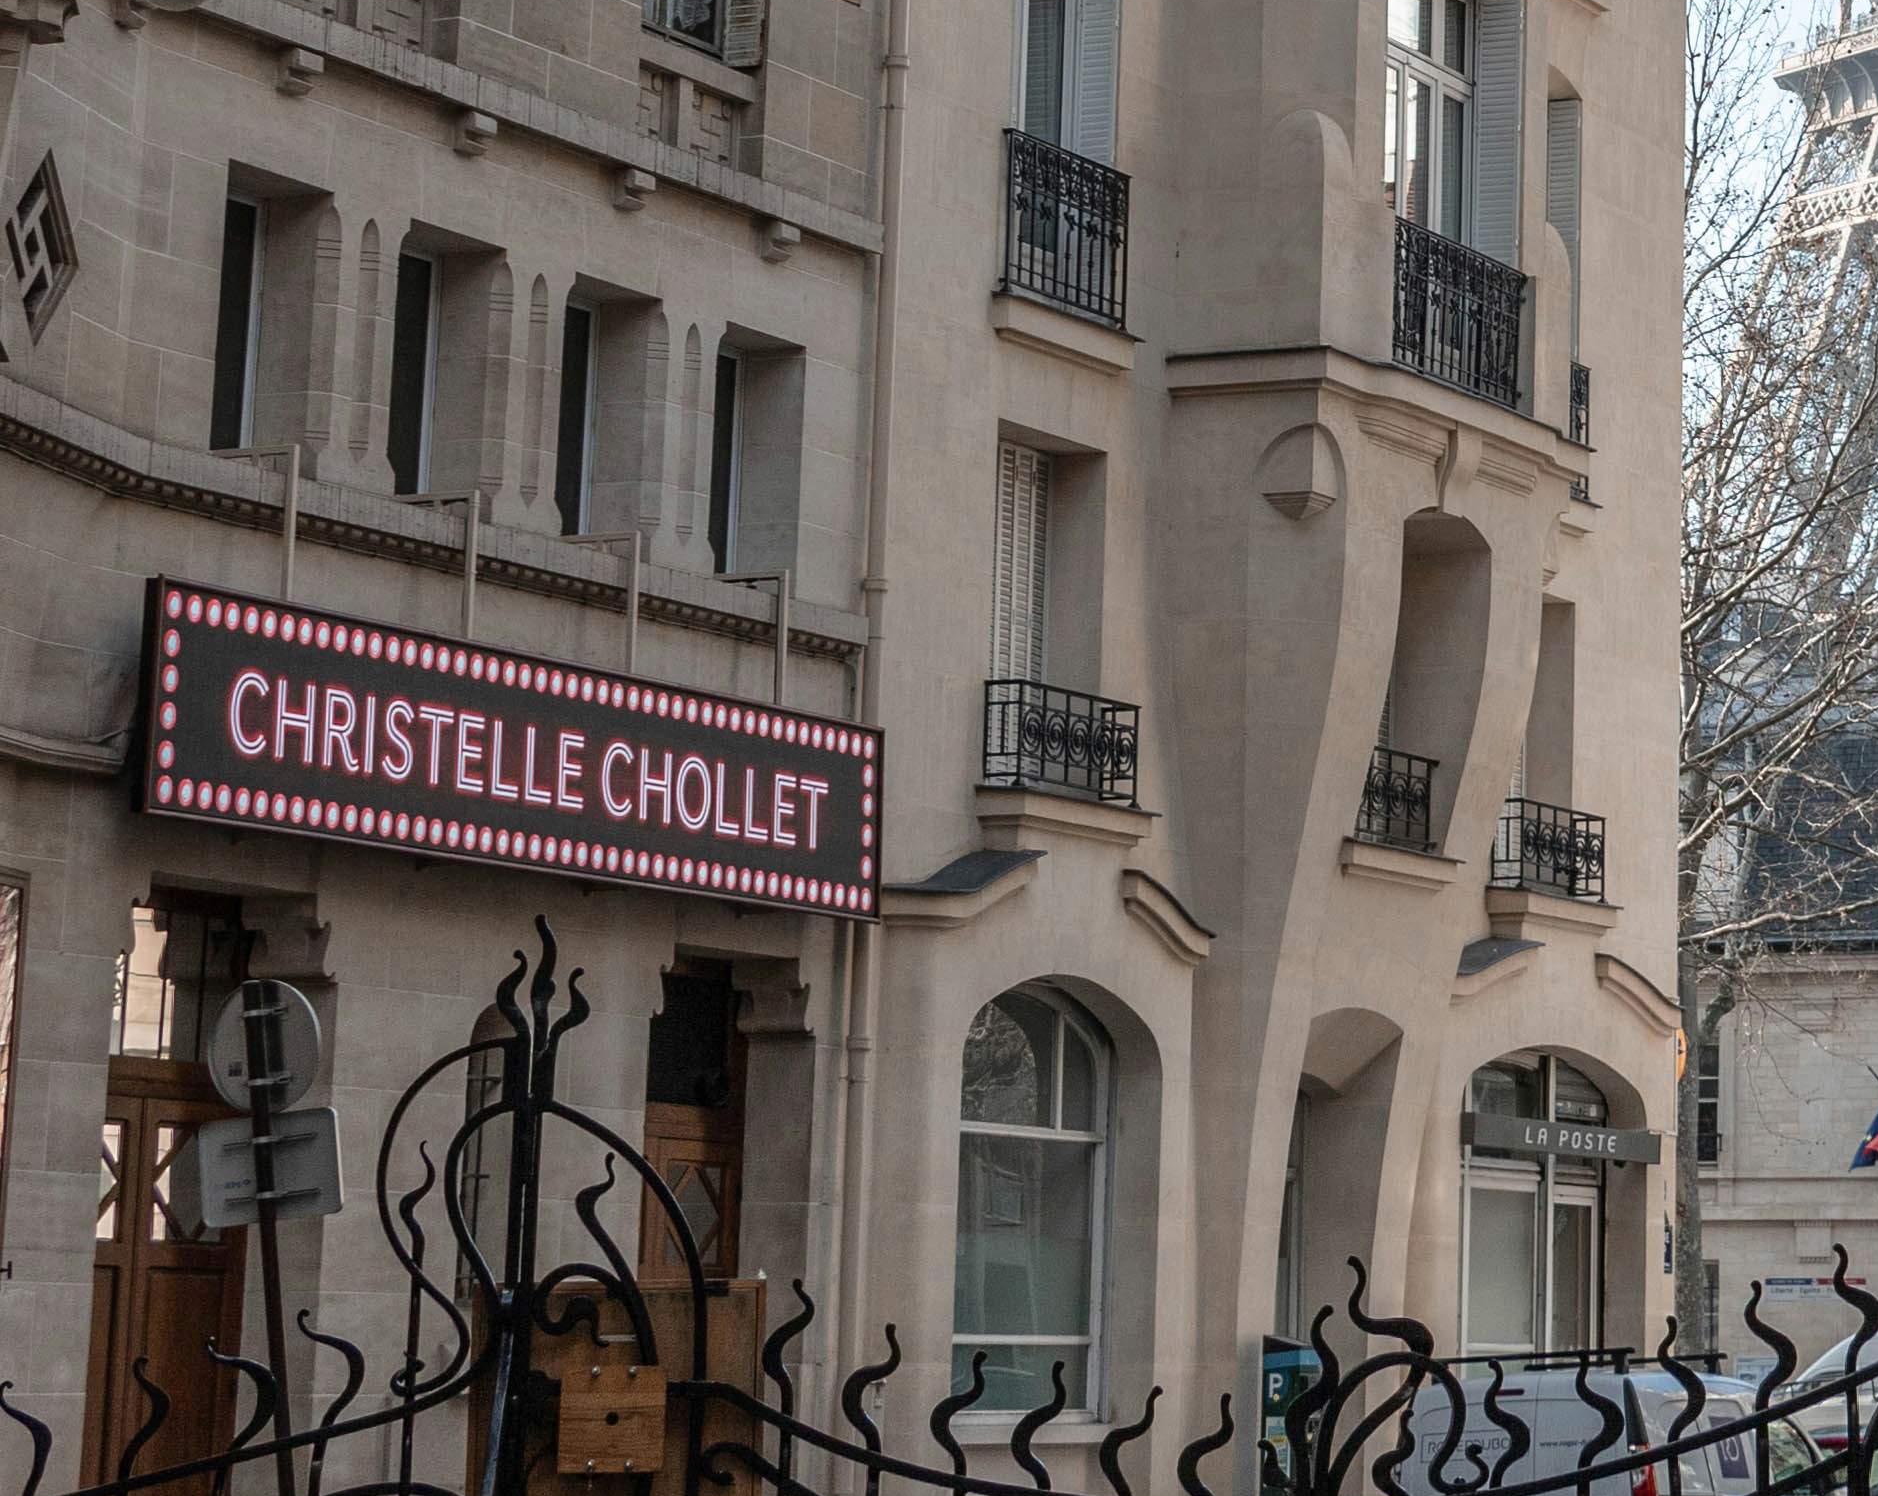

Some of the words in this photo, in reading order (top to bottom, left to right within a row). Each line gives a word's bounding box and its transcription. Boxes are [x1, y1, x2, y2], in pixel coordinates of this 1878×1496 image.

[230, 671, 585, 810] CHRISTELLE
[602, 741, 829, 850] CHOLLET
[1525, 1126, 1548, 1146] LA
[1559, 1130, 1618, 1153] POSTE
[1268, 1373, 1284, 1398] P
